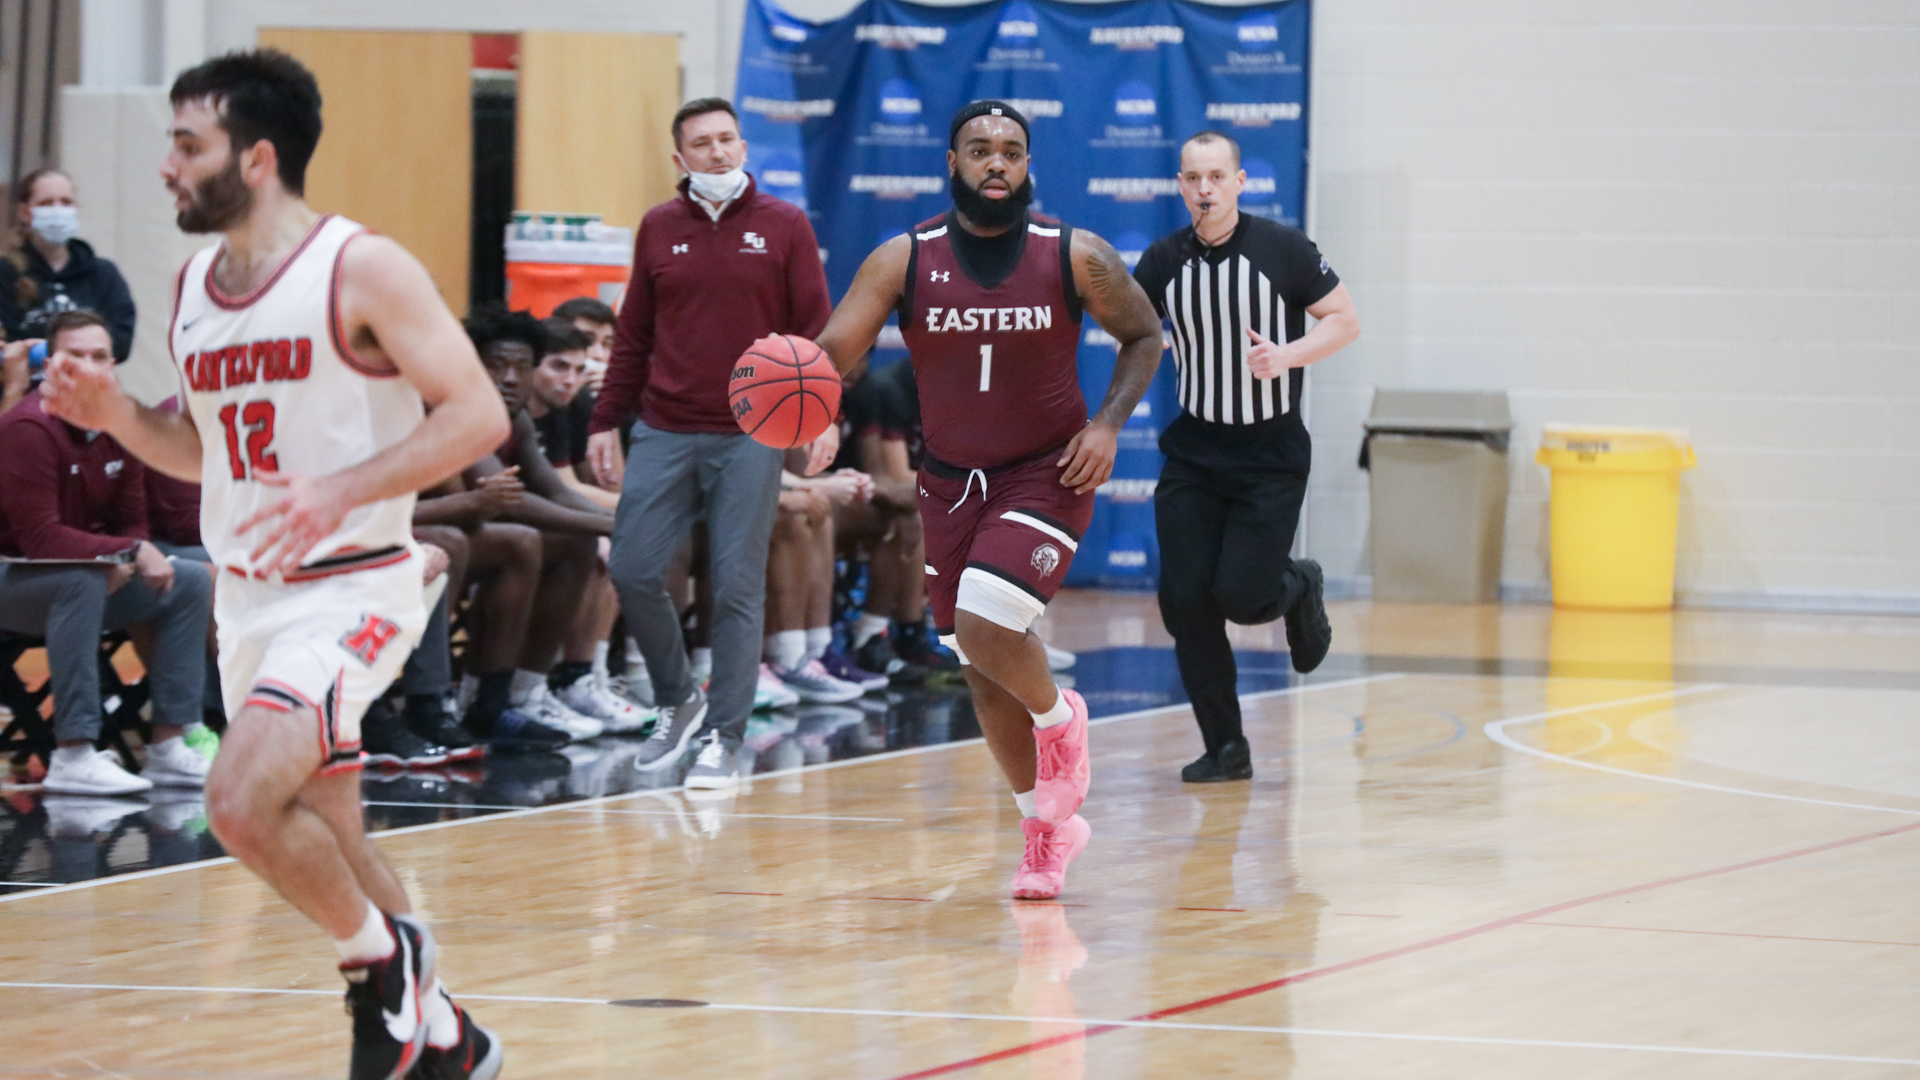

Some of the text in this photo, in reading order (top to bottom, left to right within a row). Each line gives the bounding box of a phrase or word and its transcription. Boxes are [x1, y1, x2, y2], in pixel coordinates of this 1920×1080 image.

[926, 305, 1052, 332] EASTERN
[979, 344, 993, 392] 1
[219, 399, 278, 481] 12
